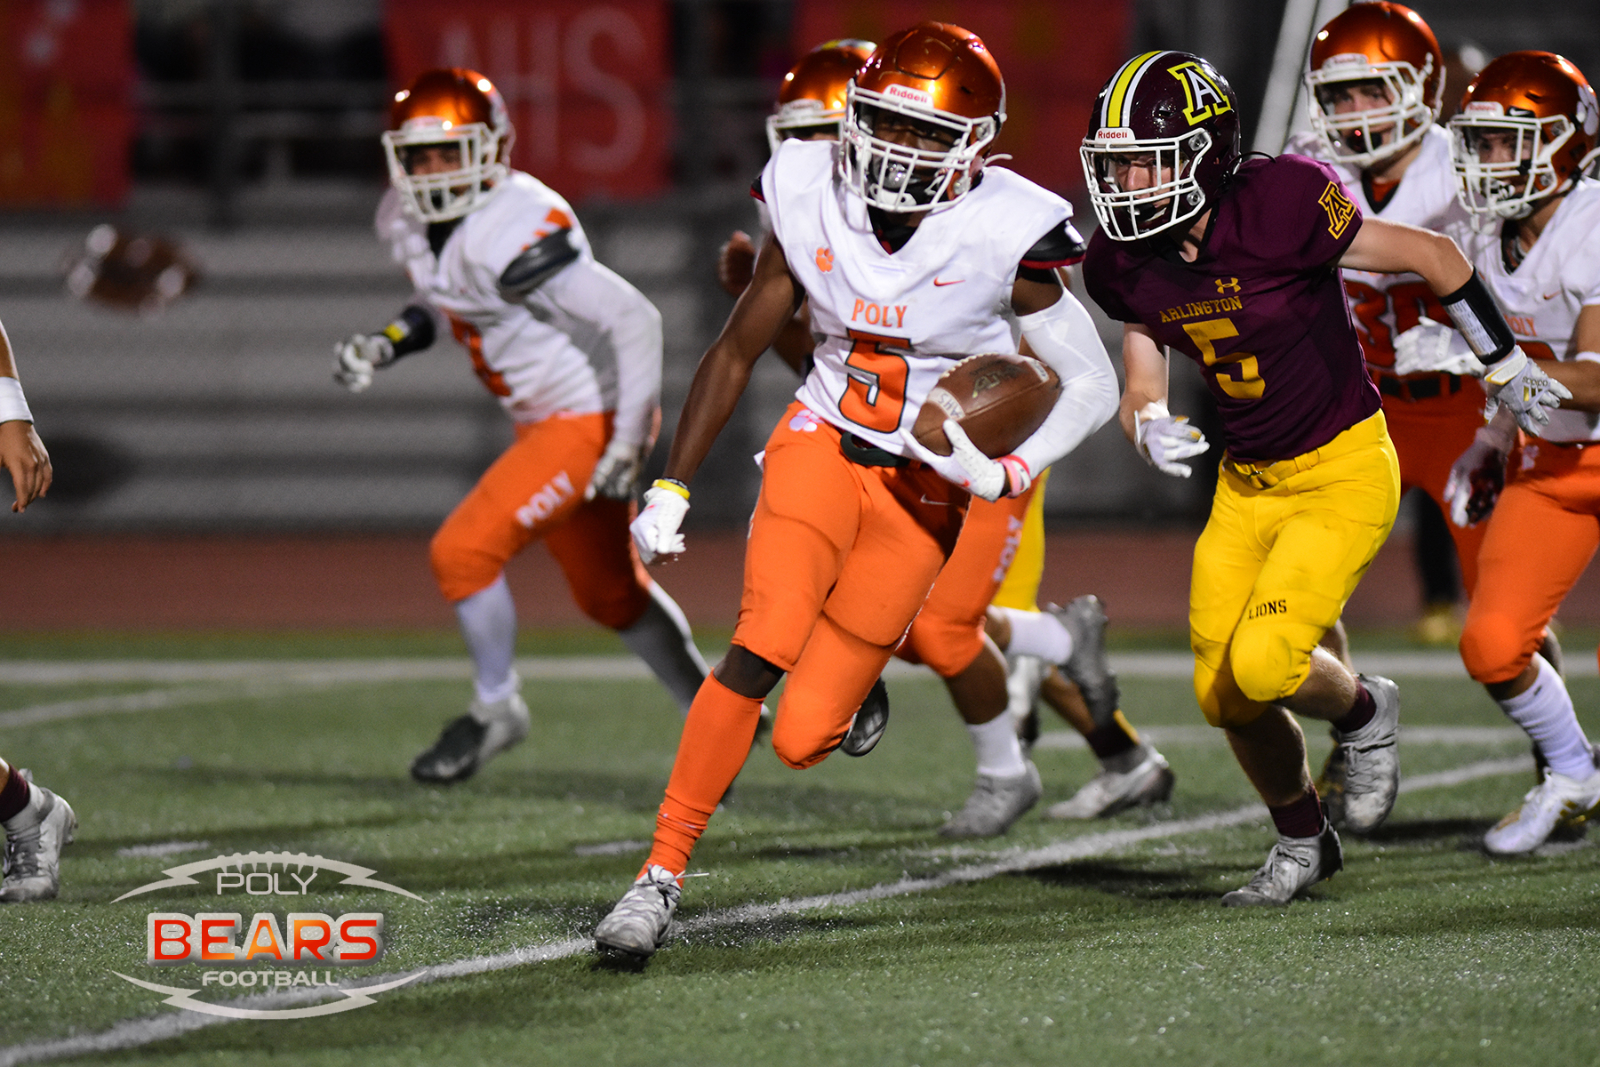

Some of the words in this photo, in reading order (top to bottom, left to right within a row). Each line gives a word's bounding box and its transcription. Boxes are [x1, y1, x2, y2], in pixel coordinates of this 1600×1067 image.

[890, 86, 927, 103] Riddell
[1167, 61, 1231, 126] A
[1098, 130, 1128, 139] Riddell
[1318, 181, 1357, 240] A
[851, 298, 908, 328] POLY
[1159, 295, 1243, 323] ARLINGTON
[1182, 317, 1266, 399] 5
[838, 327, 915, 434] 5
[515, 470, 575, 528] POLY
[1247, 599, 1287, 620] LIONS
